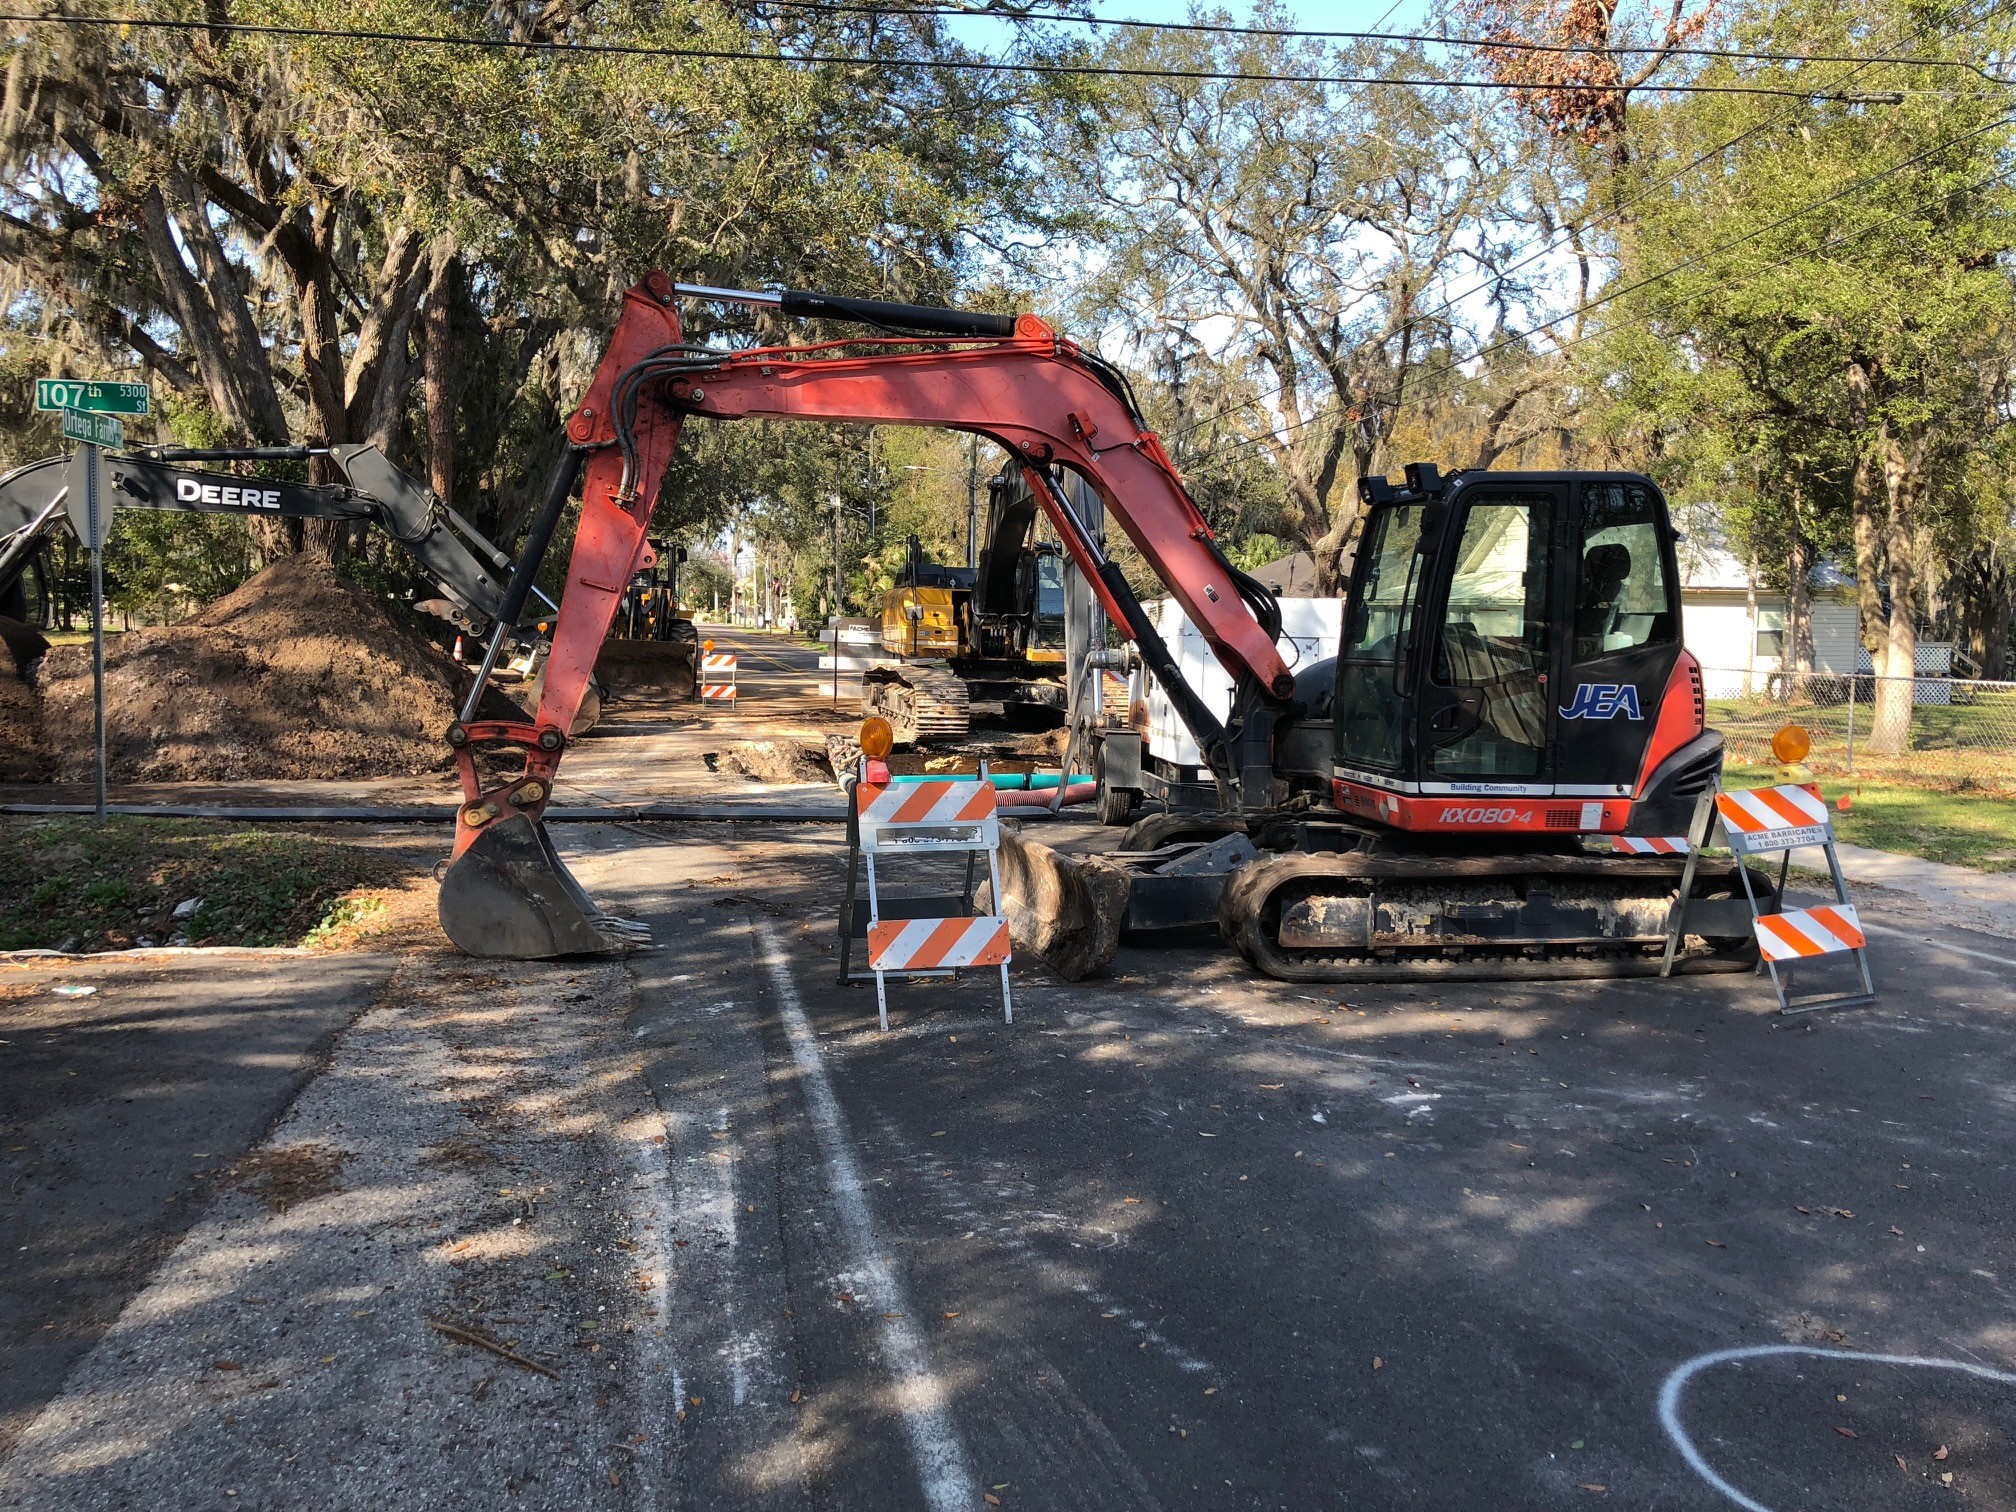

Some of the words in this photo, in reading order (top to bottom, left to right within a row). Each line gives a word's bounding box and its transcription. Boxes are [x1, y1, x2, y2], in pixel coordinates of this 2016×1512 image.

[120, 385, 146, 398] 5300
[136, 400, 146, 412] St
[64, 408, 92, 438] Ortega
[177, 478, 281, 509] DEERE
[1558, 683, 1642, 720] JEA
[1450, 783, 1482, 792] Building
[1484, 784, 1527, 793] Community
[1438, 807, 1534, 824] KX080-4
[1747, 832, 1769, 842] ACME
[1771, 827, 1822, 838] BARRICADES
[1764, 840, 1778, 848] 800
[1780, 835, 1816, 845] 373-7704
